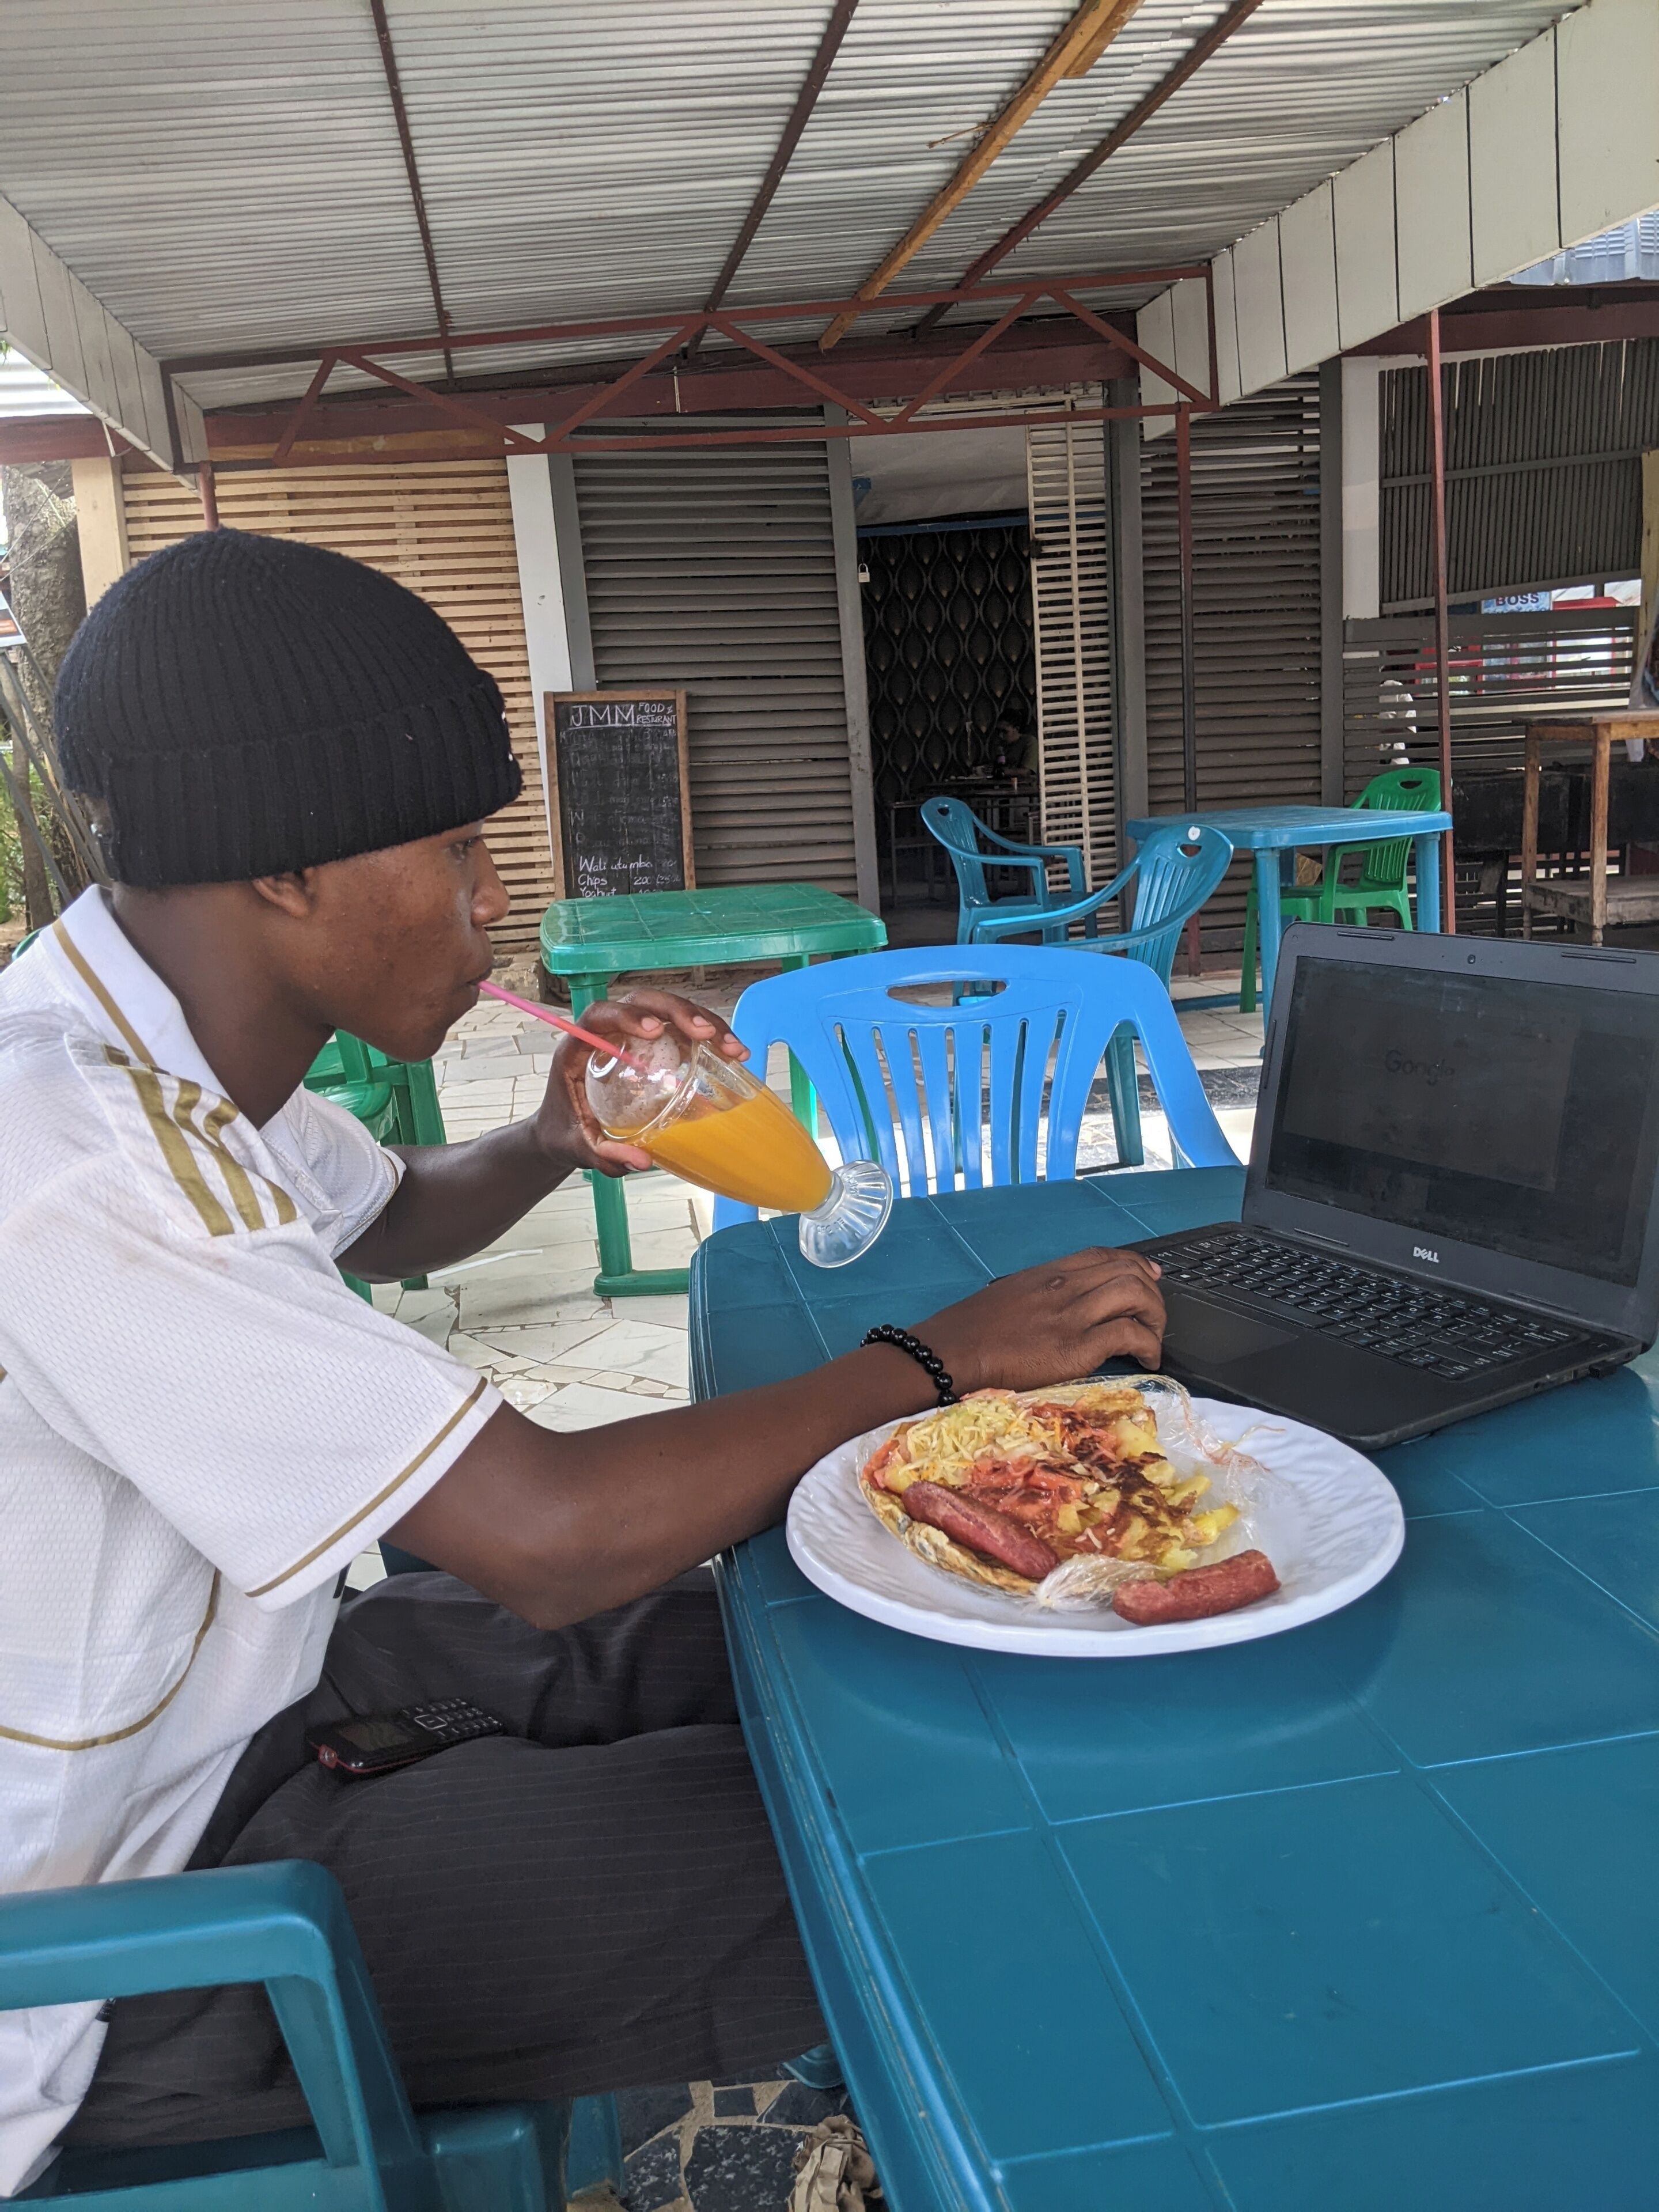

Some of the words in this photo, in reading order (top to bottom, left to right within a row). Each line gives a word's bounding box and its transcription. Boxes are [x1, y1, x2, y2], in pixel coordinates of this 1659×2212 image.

[1496, 593, 1539, 606] BOSS
[572, 704, 634, 726] JMM
[638, 702, 665, 713] FOOD
[579, 855, 607, 872] Wali
[578, 874, 608, 889] Chips
[1413, 1246, 1440, 1263] DELL
